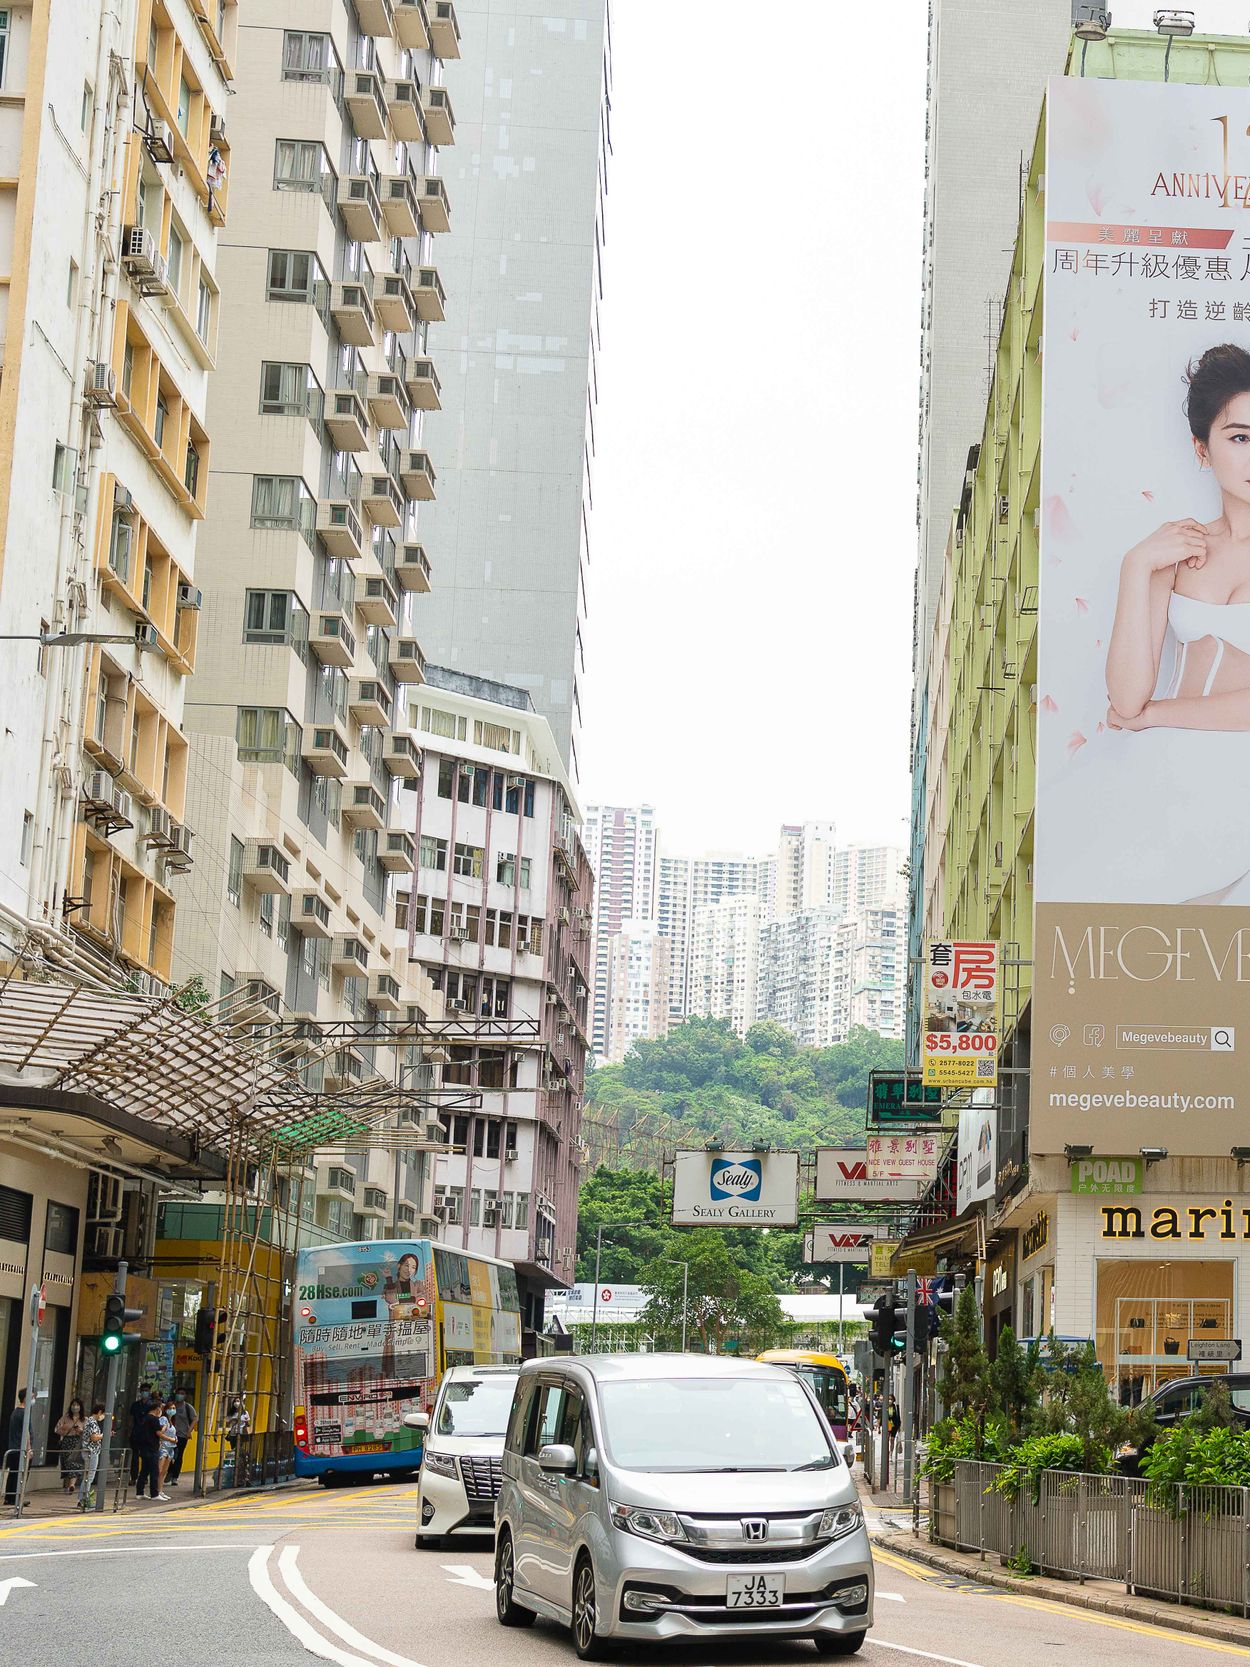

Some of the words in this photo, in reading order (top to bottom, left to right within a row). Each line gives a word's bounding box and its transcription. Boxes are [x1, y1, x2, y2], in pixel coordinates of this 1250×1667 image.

[1098, 226, 1189, 247] 美麗呈獻
[1053, 248, 1232, 282] 周年升級優惠
[926, 1033, 997, 1053] $5,800
[1122, 1031, 1208, 1046] Megevebeauty
[1049, 1090, 1235, 1113] megevebeauty.com
[717, 1170, 753, 1189] Sealy
[1079, 1161, 1136, 1183] POAD
[299, 1285, 363, 1300] 28Hse.com
[744, 1576, 767, 1590] JA
[732, 1590, 778, 1606] 7333
